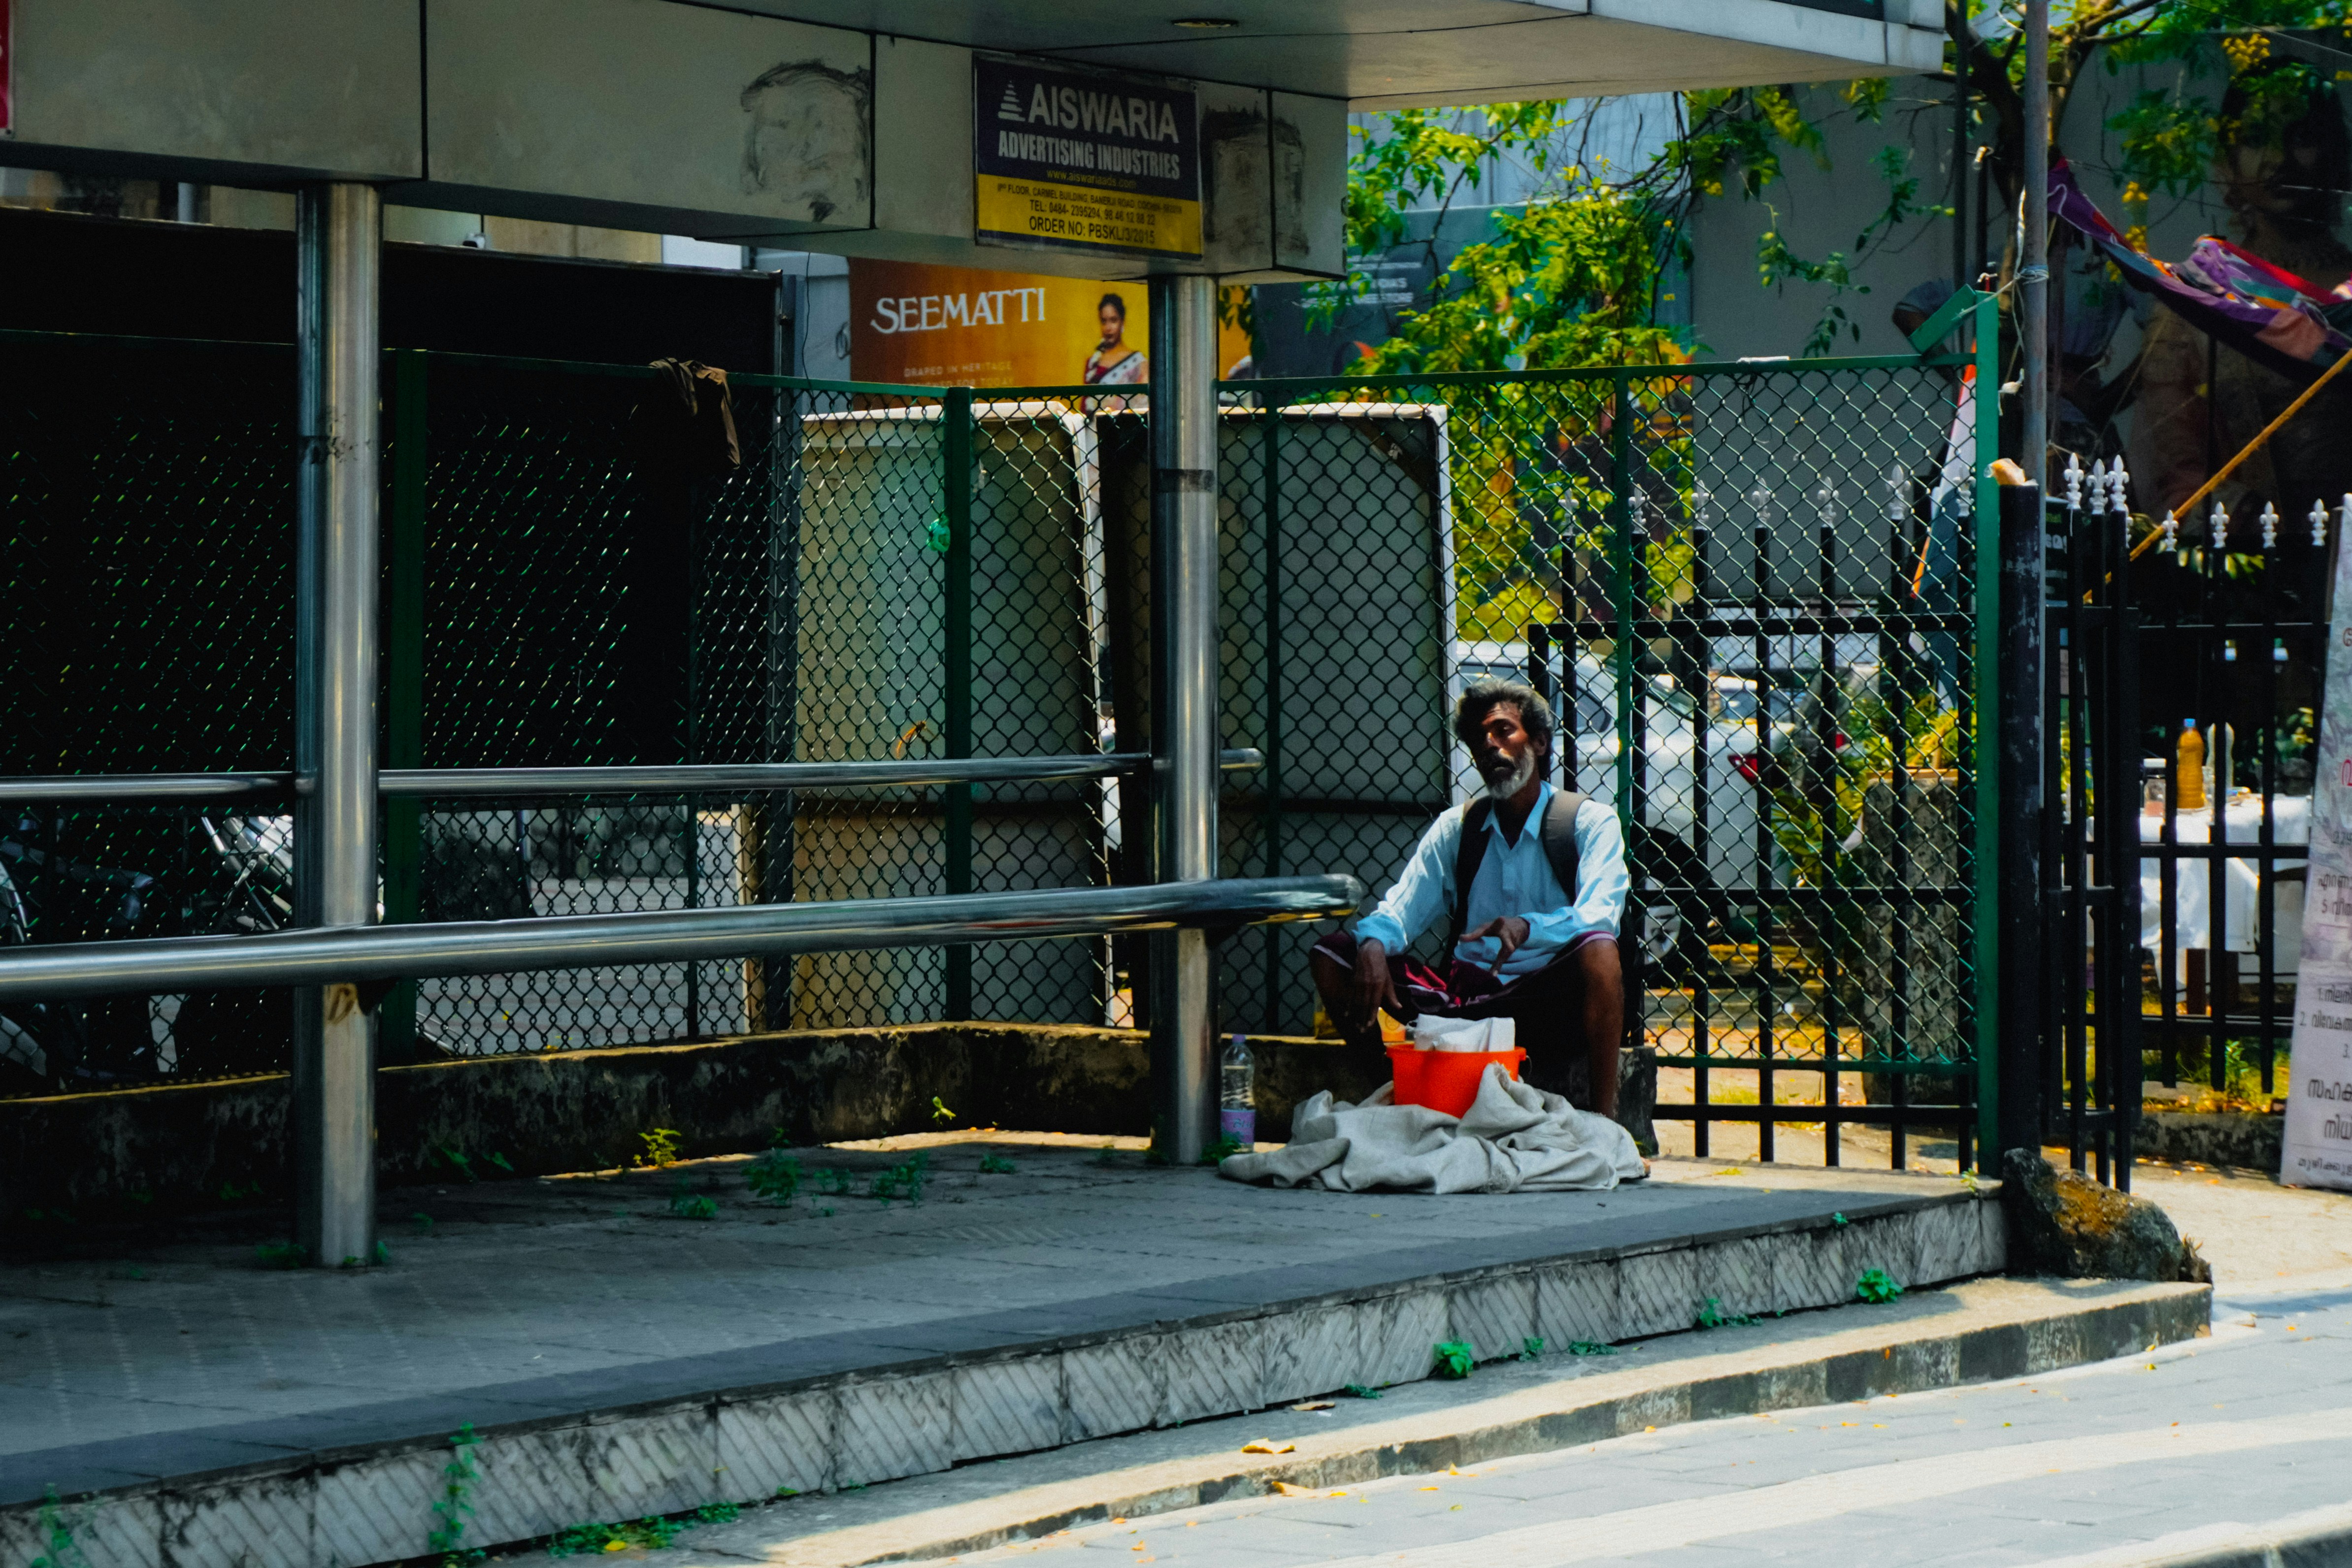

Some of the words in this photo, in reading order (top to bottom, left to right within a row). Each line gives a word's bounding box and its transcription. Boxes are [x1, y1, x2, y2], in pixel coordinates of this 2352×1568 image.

[1028, 83, 1179, 143] AISWARIA
[998, 131, 1094, 169] ADVERTISING
[1098, 144, 1180, 180] INDUSTRIES
[1047, 169, 1136, 189] www.aiswariaads.com
[1032, 187, 1058, 199] CARMEL
[1029, 199, 1047, 212] TEL:
[1029, 216, 1065, 234] ORDER
[1068, 220, 1086, 237] NO:
[870, 288, 1046, 335] SEEMATTI
[903, 365, 944, 378] DRAPED
